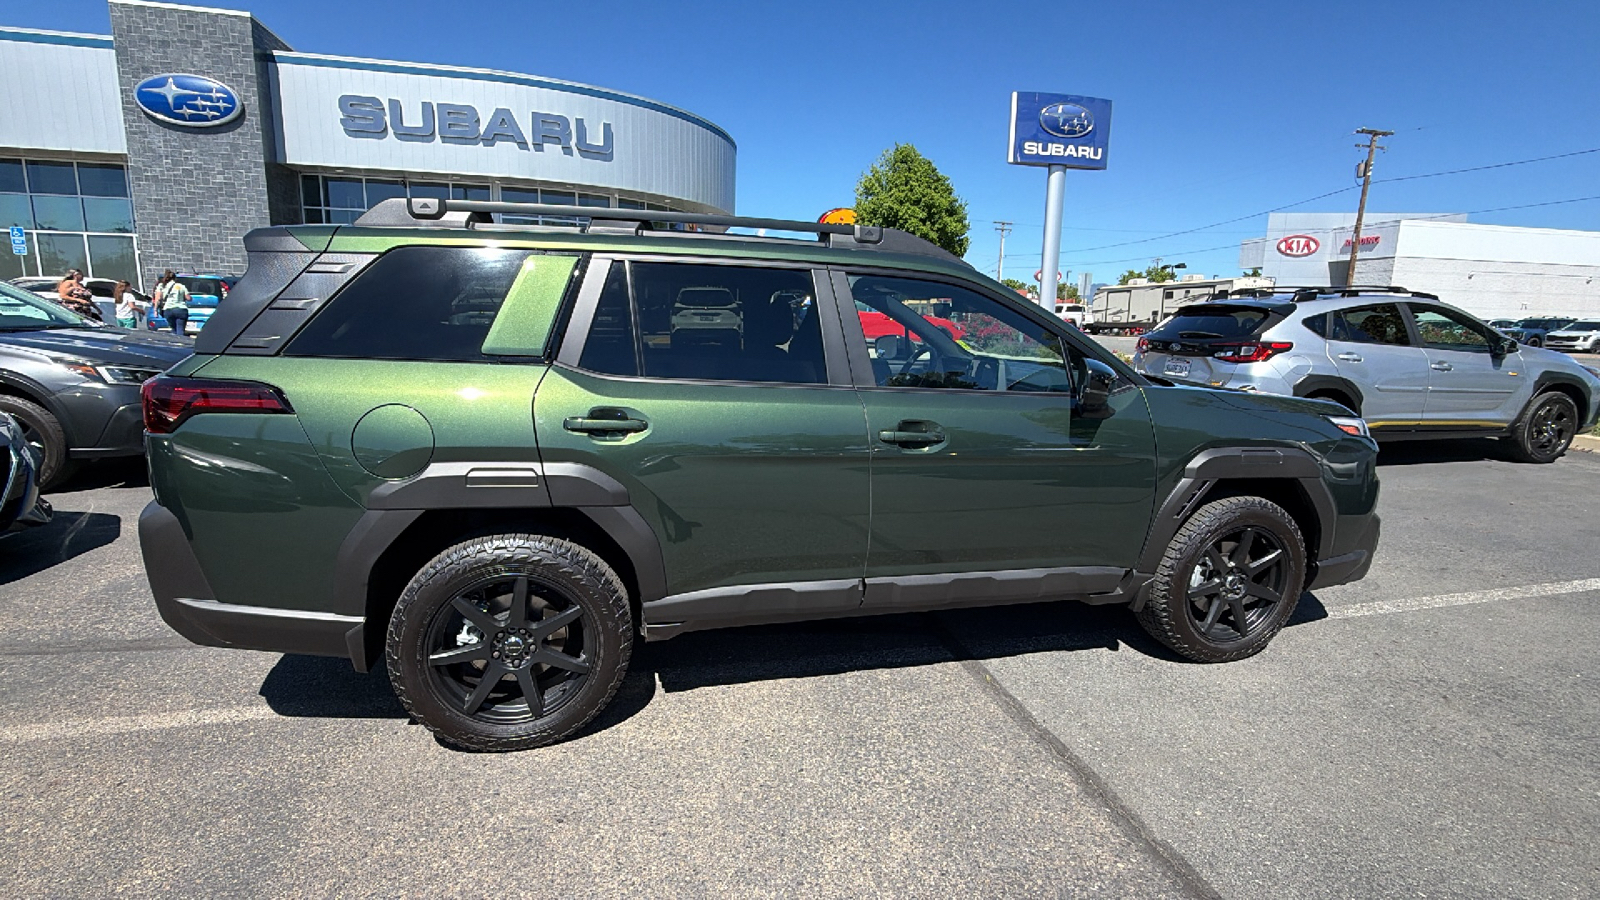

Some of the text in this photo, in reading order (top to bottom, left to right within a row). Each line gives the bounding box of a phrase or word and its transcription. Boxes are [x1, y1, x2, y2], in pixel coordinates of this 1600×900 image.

[338, 95, 613, 156] SUBARU
[1023, 141, 1102, 160] SUBARU
[1284, 239, 1312, 253] KIA
